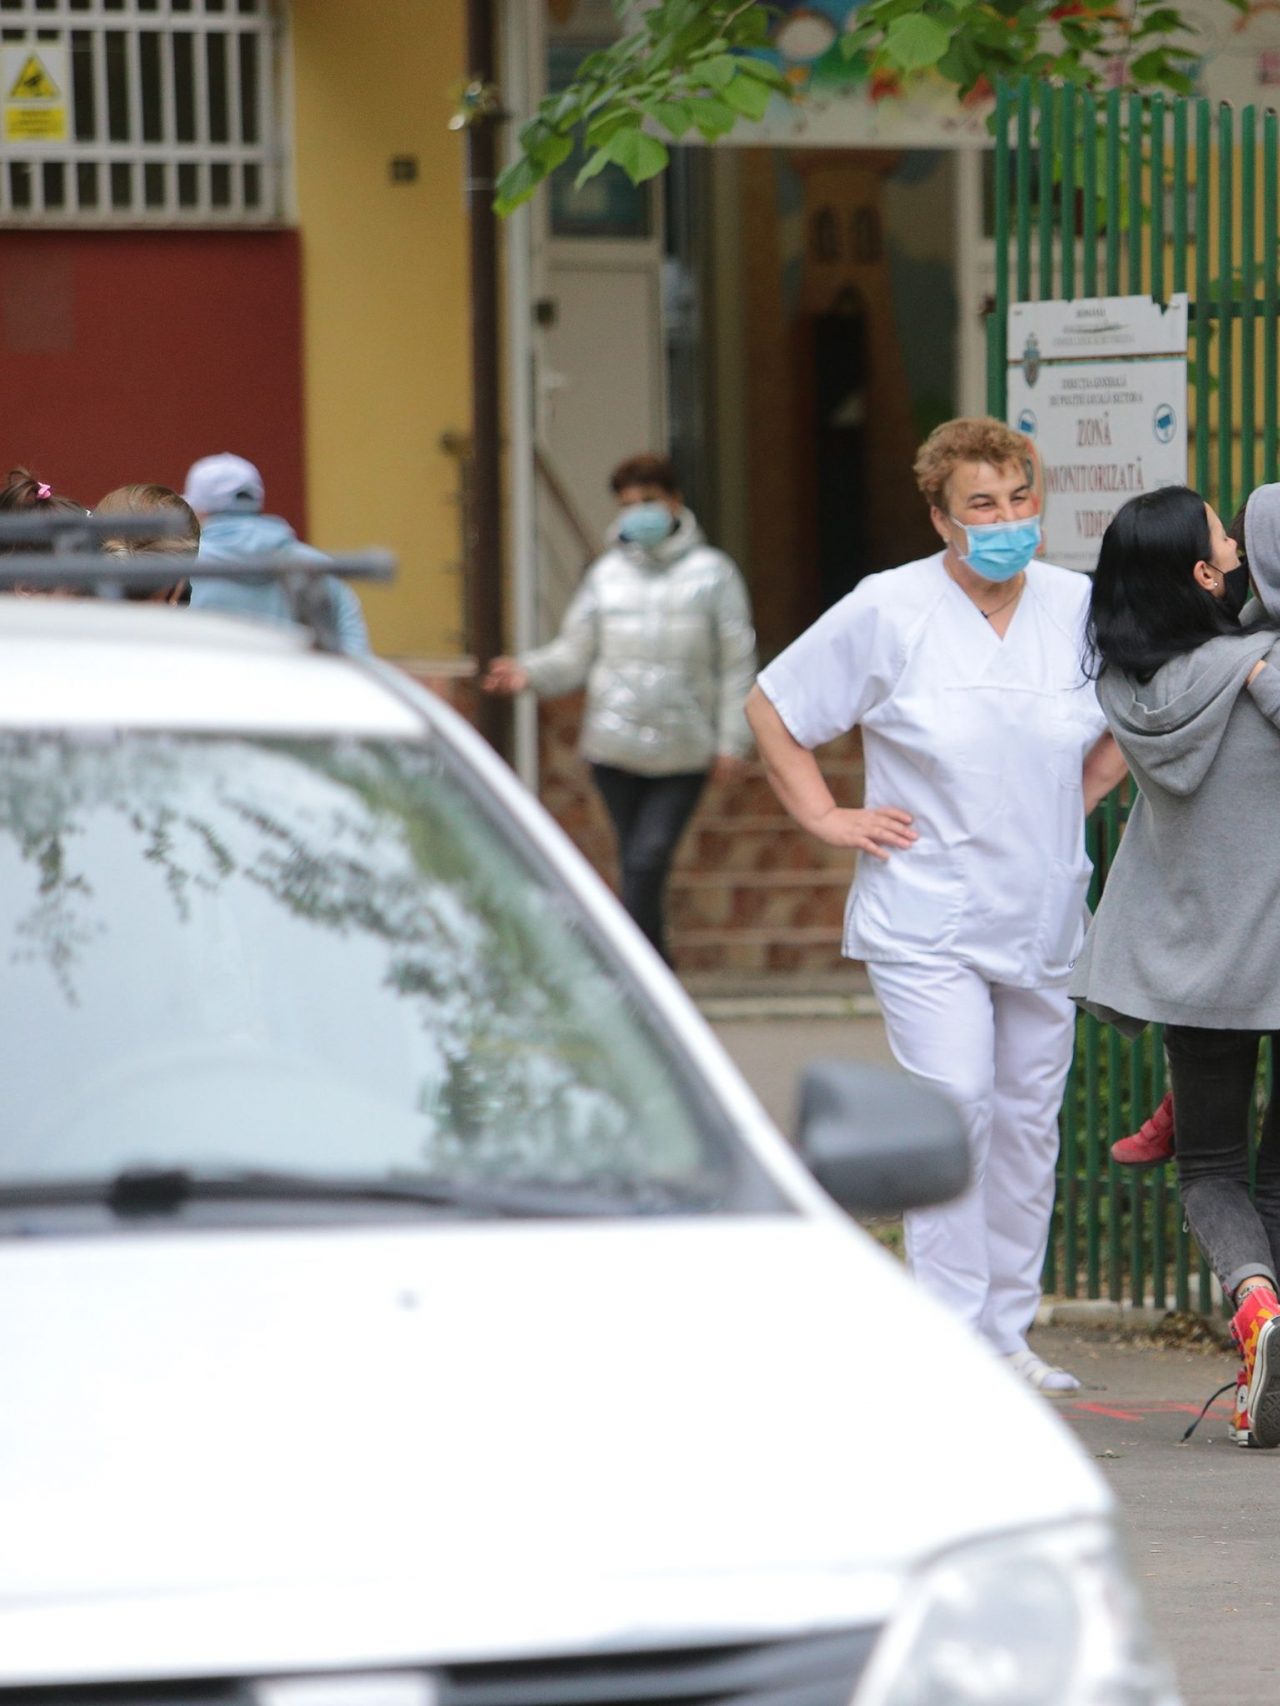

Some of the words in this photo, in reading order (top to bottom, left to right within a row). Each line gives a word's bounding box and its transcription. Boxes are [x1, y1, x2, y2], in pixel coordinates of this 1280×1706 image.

[1077, 411, 1112, 447] ZONĂ
[1046, 456, 1144, 492] MONITORIZATĂ
[1075, 509, 1114, 542] VIDE
